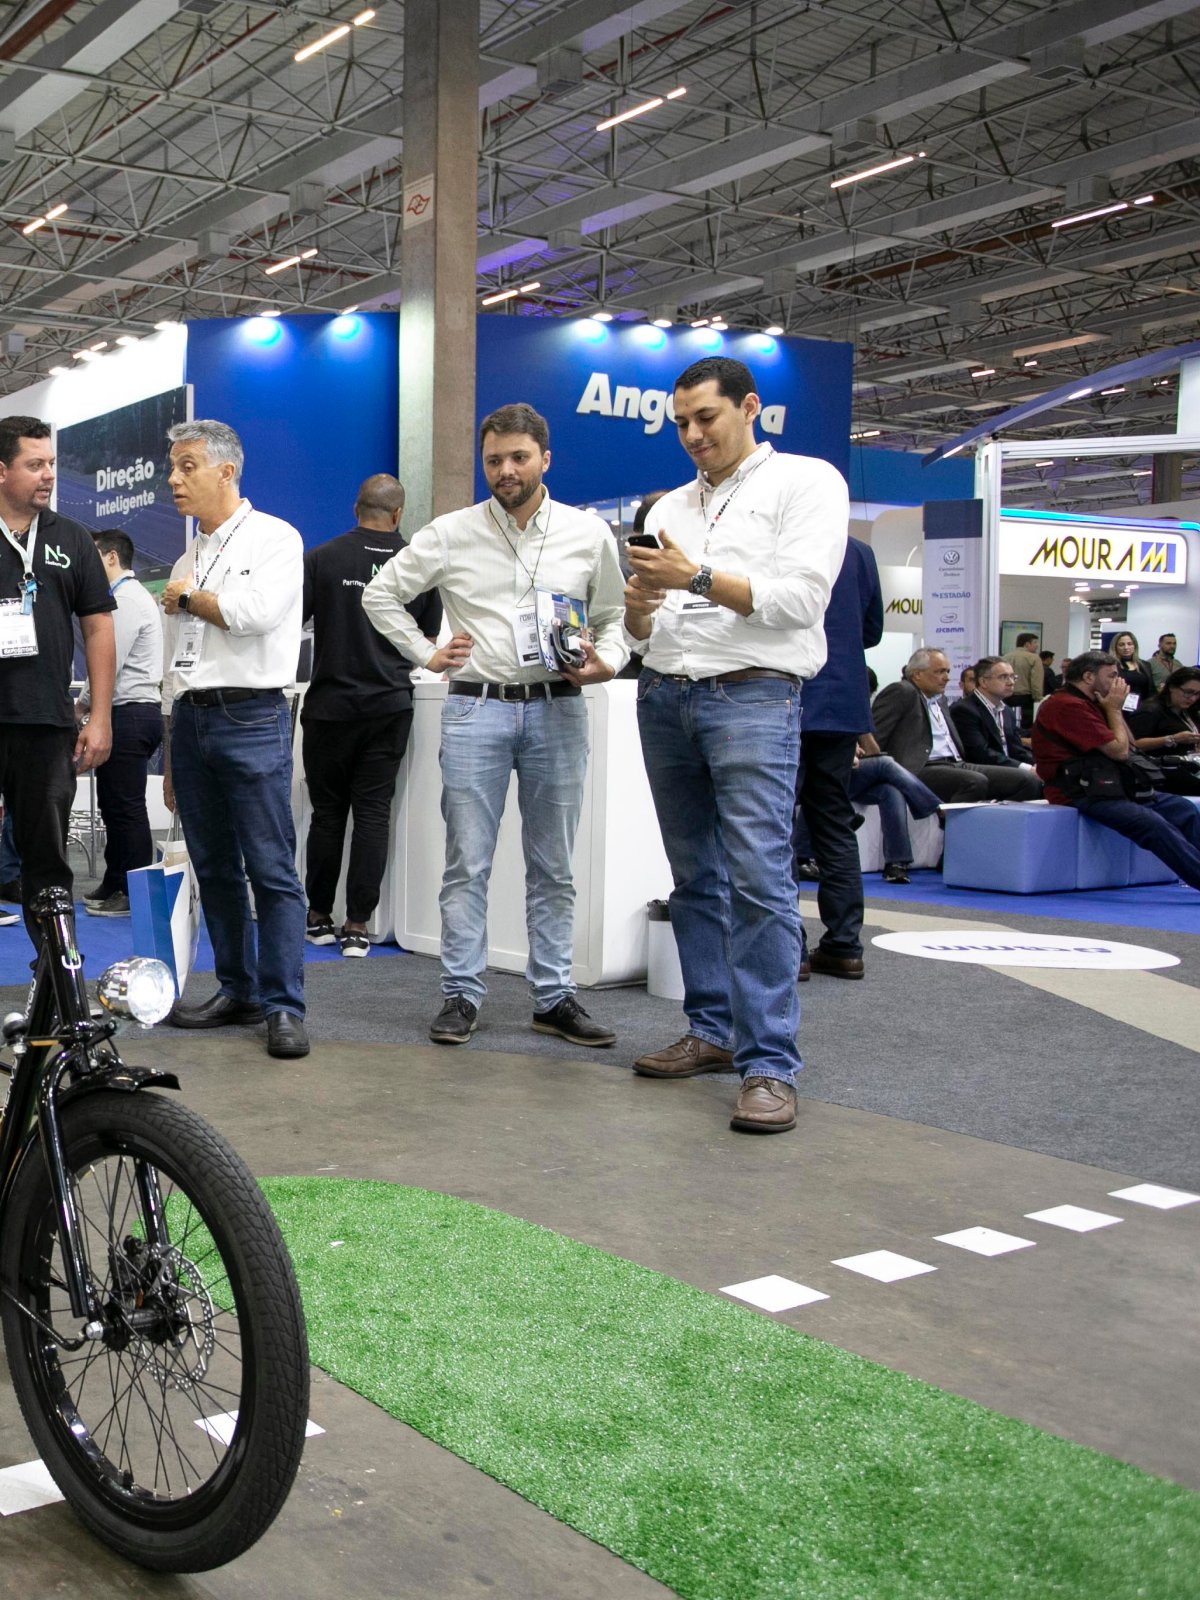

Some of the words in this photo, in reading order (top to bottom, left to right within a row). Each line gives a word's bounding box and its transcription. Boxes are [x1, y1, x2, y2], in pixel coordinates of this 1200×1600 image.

[96, 457, 154, 493] Direção
[96, 490, 155, 517] Inteligente
[1029, 535, 1134, 571] MOURA
[885, 598, 922, 615] MOU
[939, 591, 971, 599] ESTADÃO
